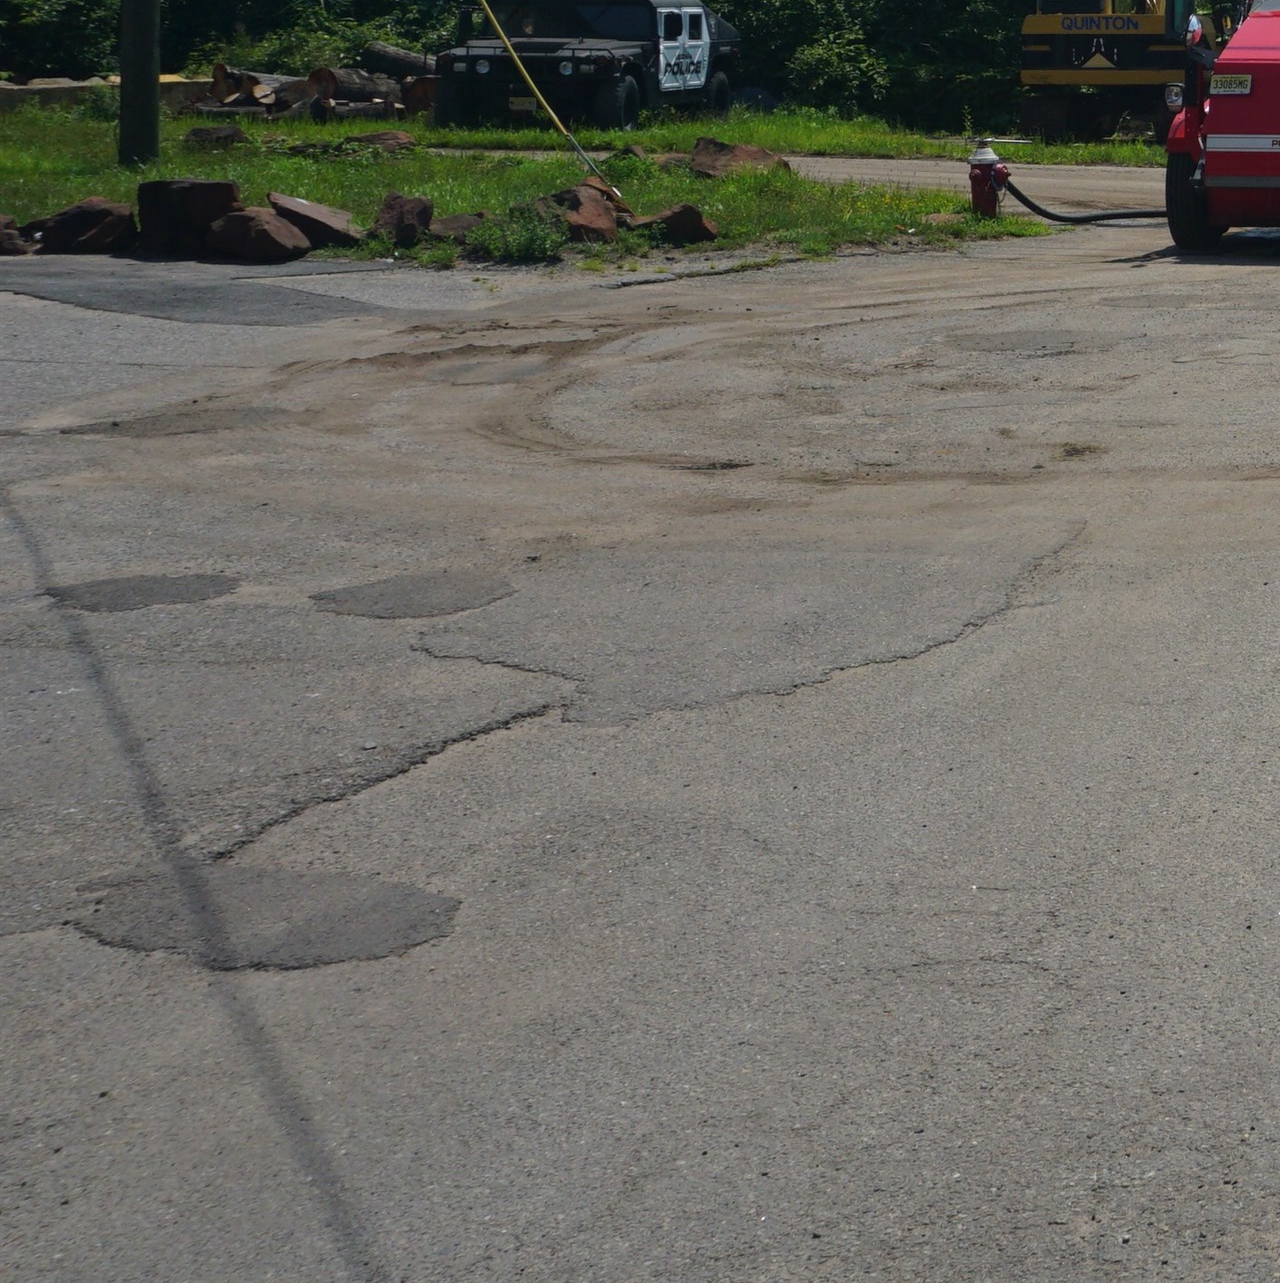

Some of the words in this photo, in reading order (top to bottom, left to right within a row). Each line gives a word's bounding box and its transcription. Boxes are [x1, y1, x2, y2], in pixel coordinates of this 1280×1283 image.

[1061, 17, 1139, 30] QUINTON
[664, 61, 702, 76] POLICE
[1213, 79, 1249, 89] 33085MG
